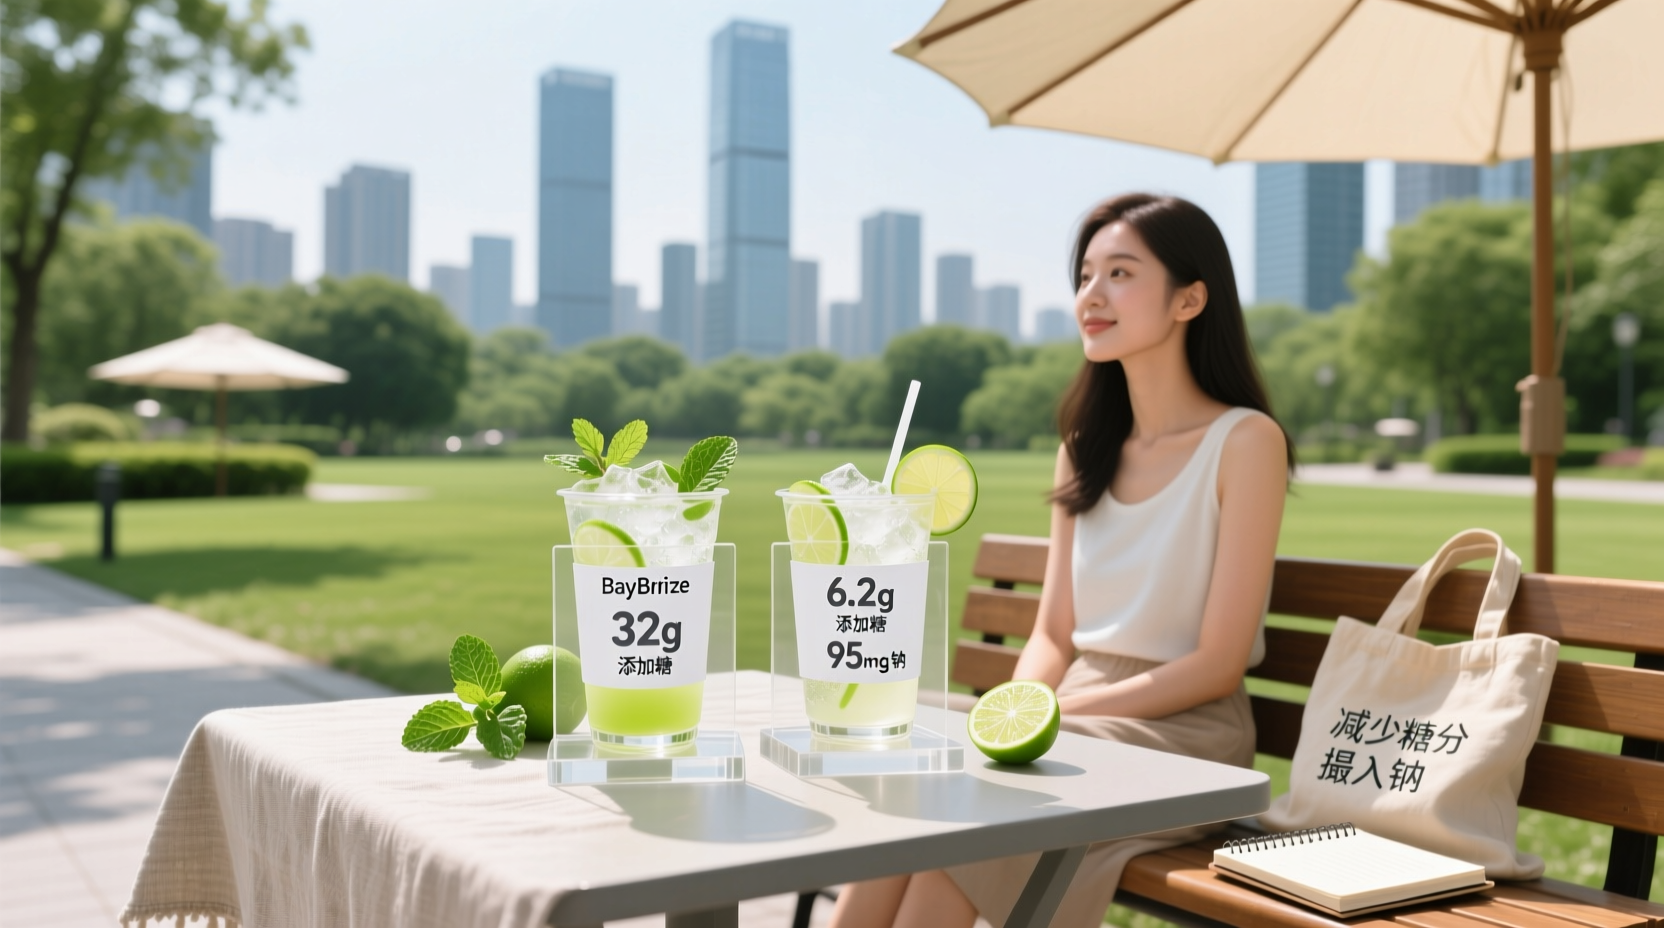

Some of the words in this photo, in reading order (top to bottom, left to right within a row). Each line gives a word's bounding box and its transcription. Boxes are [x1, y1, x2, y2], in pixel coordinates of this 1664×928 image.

[602, 576, 690, 600] BayBrrize
[827, 577, 894, 613] 6.2g
[612, 611, 681, 653] 32g
[836, 614, 887, 633] 添加糖
[618, 656, 672, 675] 添加糖
[1330, 707, 1469, 754] 减少糖分
